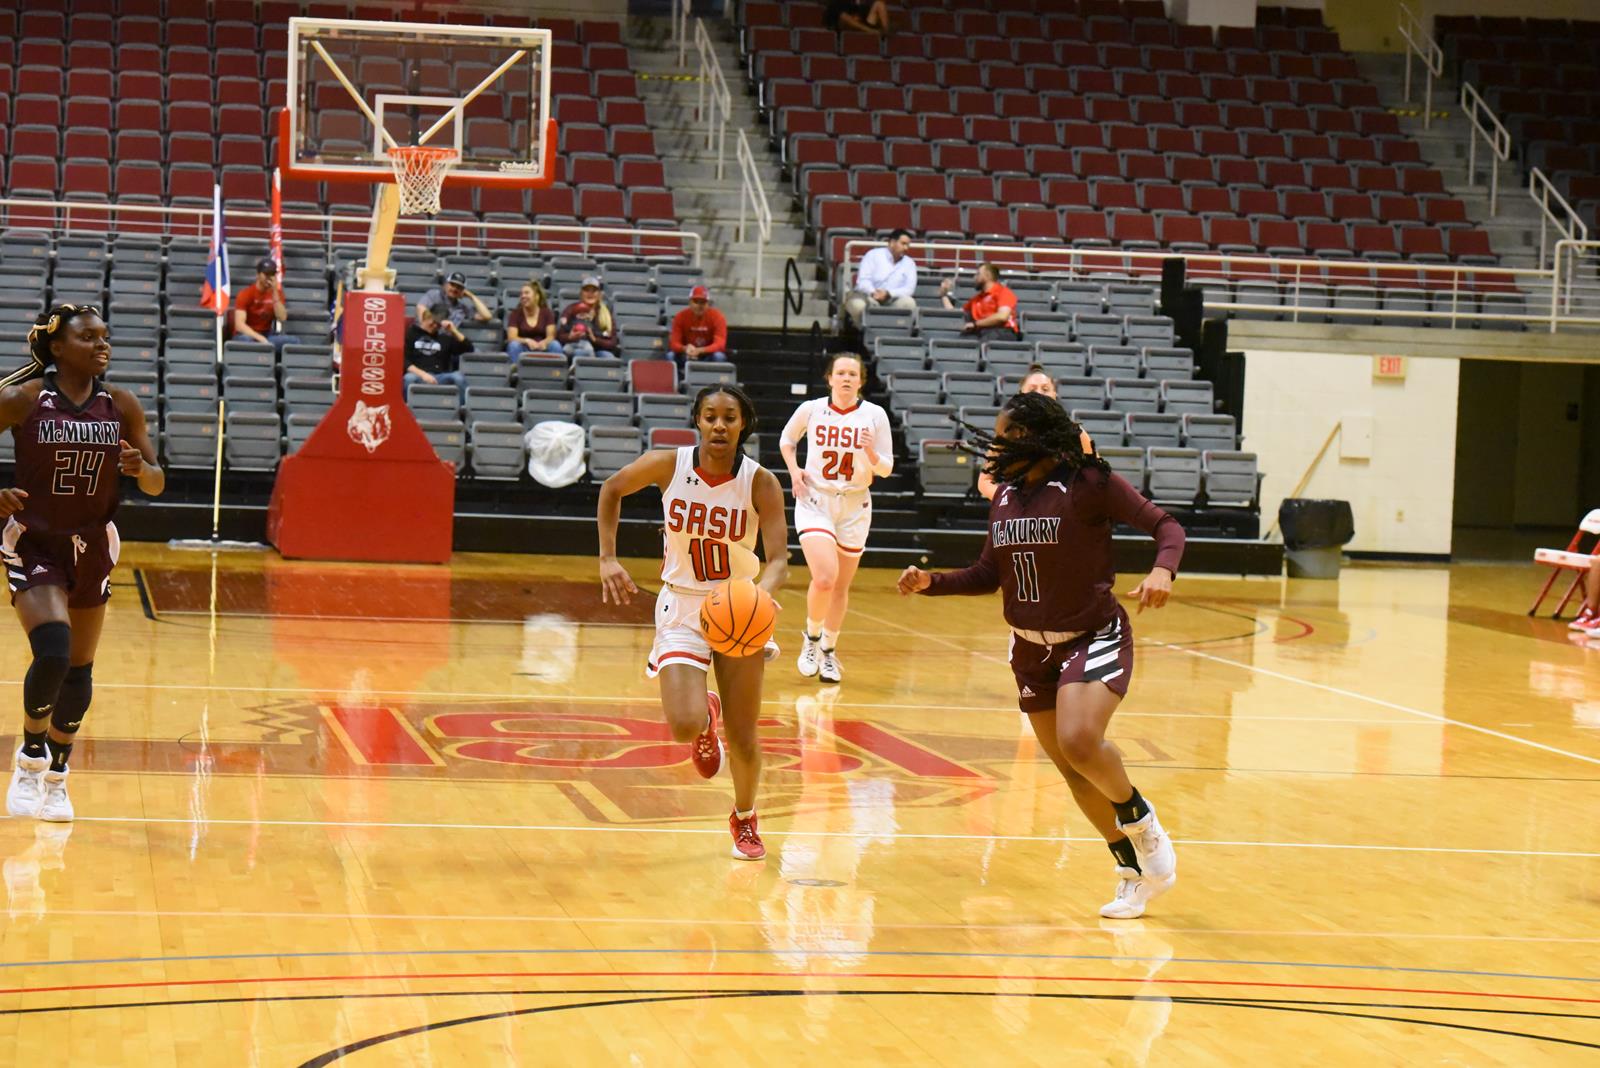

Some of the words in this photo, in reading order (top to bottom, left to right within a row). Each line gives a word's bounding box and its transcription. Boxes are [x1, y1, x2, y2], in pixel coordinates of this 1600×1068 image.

[1379, 356, 1402, 374] EXIT
[38, 419, 121, 446] McMURRY
[51, 450, 106, 496] 24
[821, 450, 855, 482] 24
[992, 517, 1061, 548] McMURRY
[688, 538, 731, 582] 10
[1012, 551, 1040, 603] 11
